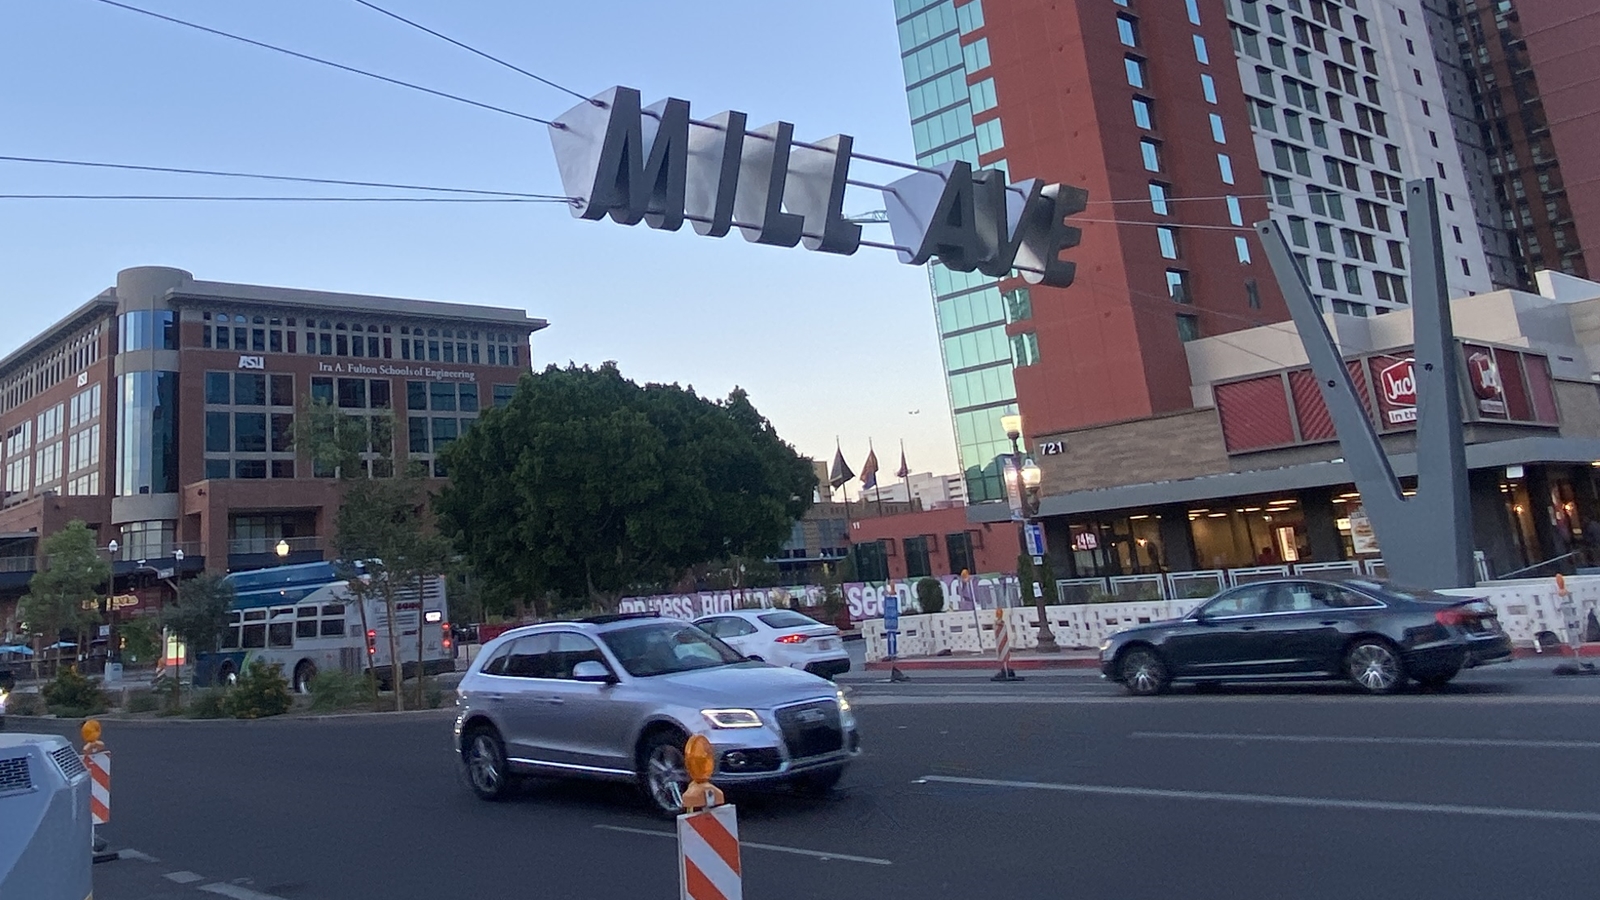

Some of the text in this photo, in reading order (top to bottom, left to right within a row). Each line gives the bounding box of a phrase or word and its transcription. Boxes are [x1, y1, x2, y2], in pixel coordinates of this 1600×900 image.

[572, 85, 1089, 288] MILL AVE
[238, 355, 265, 370] ASU
[319, 362, 475, 381] Ira A. Fulton Schools of Engineering
[1404, 410, 1417, 419] th
[1039, 441, 1064, 456] 721
[852, 521, 861, 530] 11
[1075, 533, 1086, 546] 24
